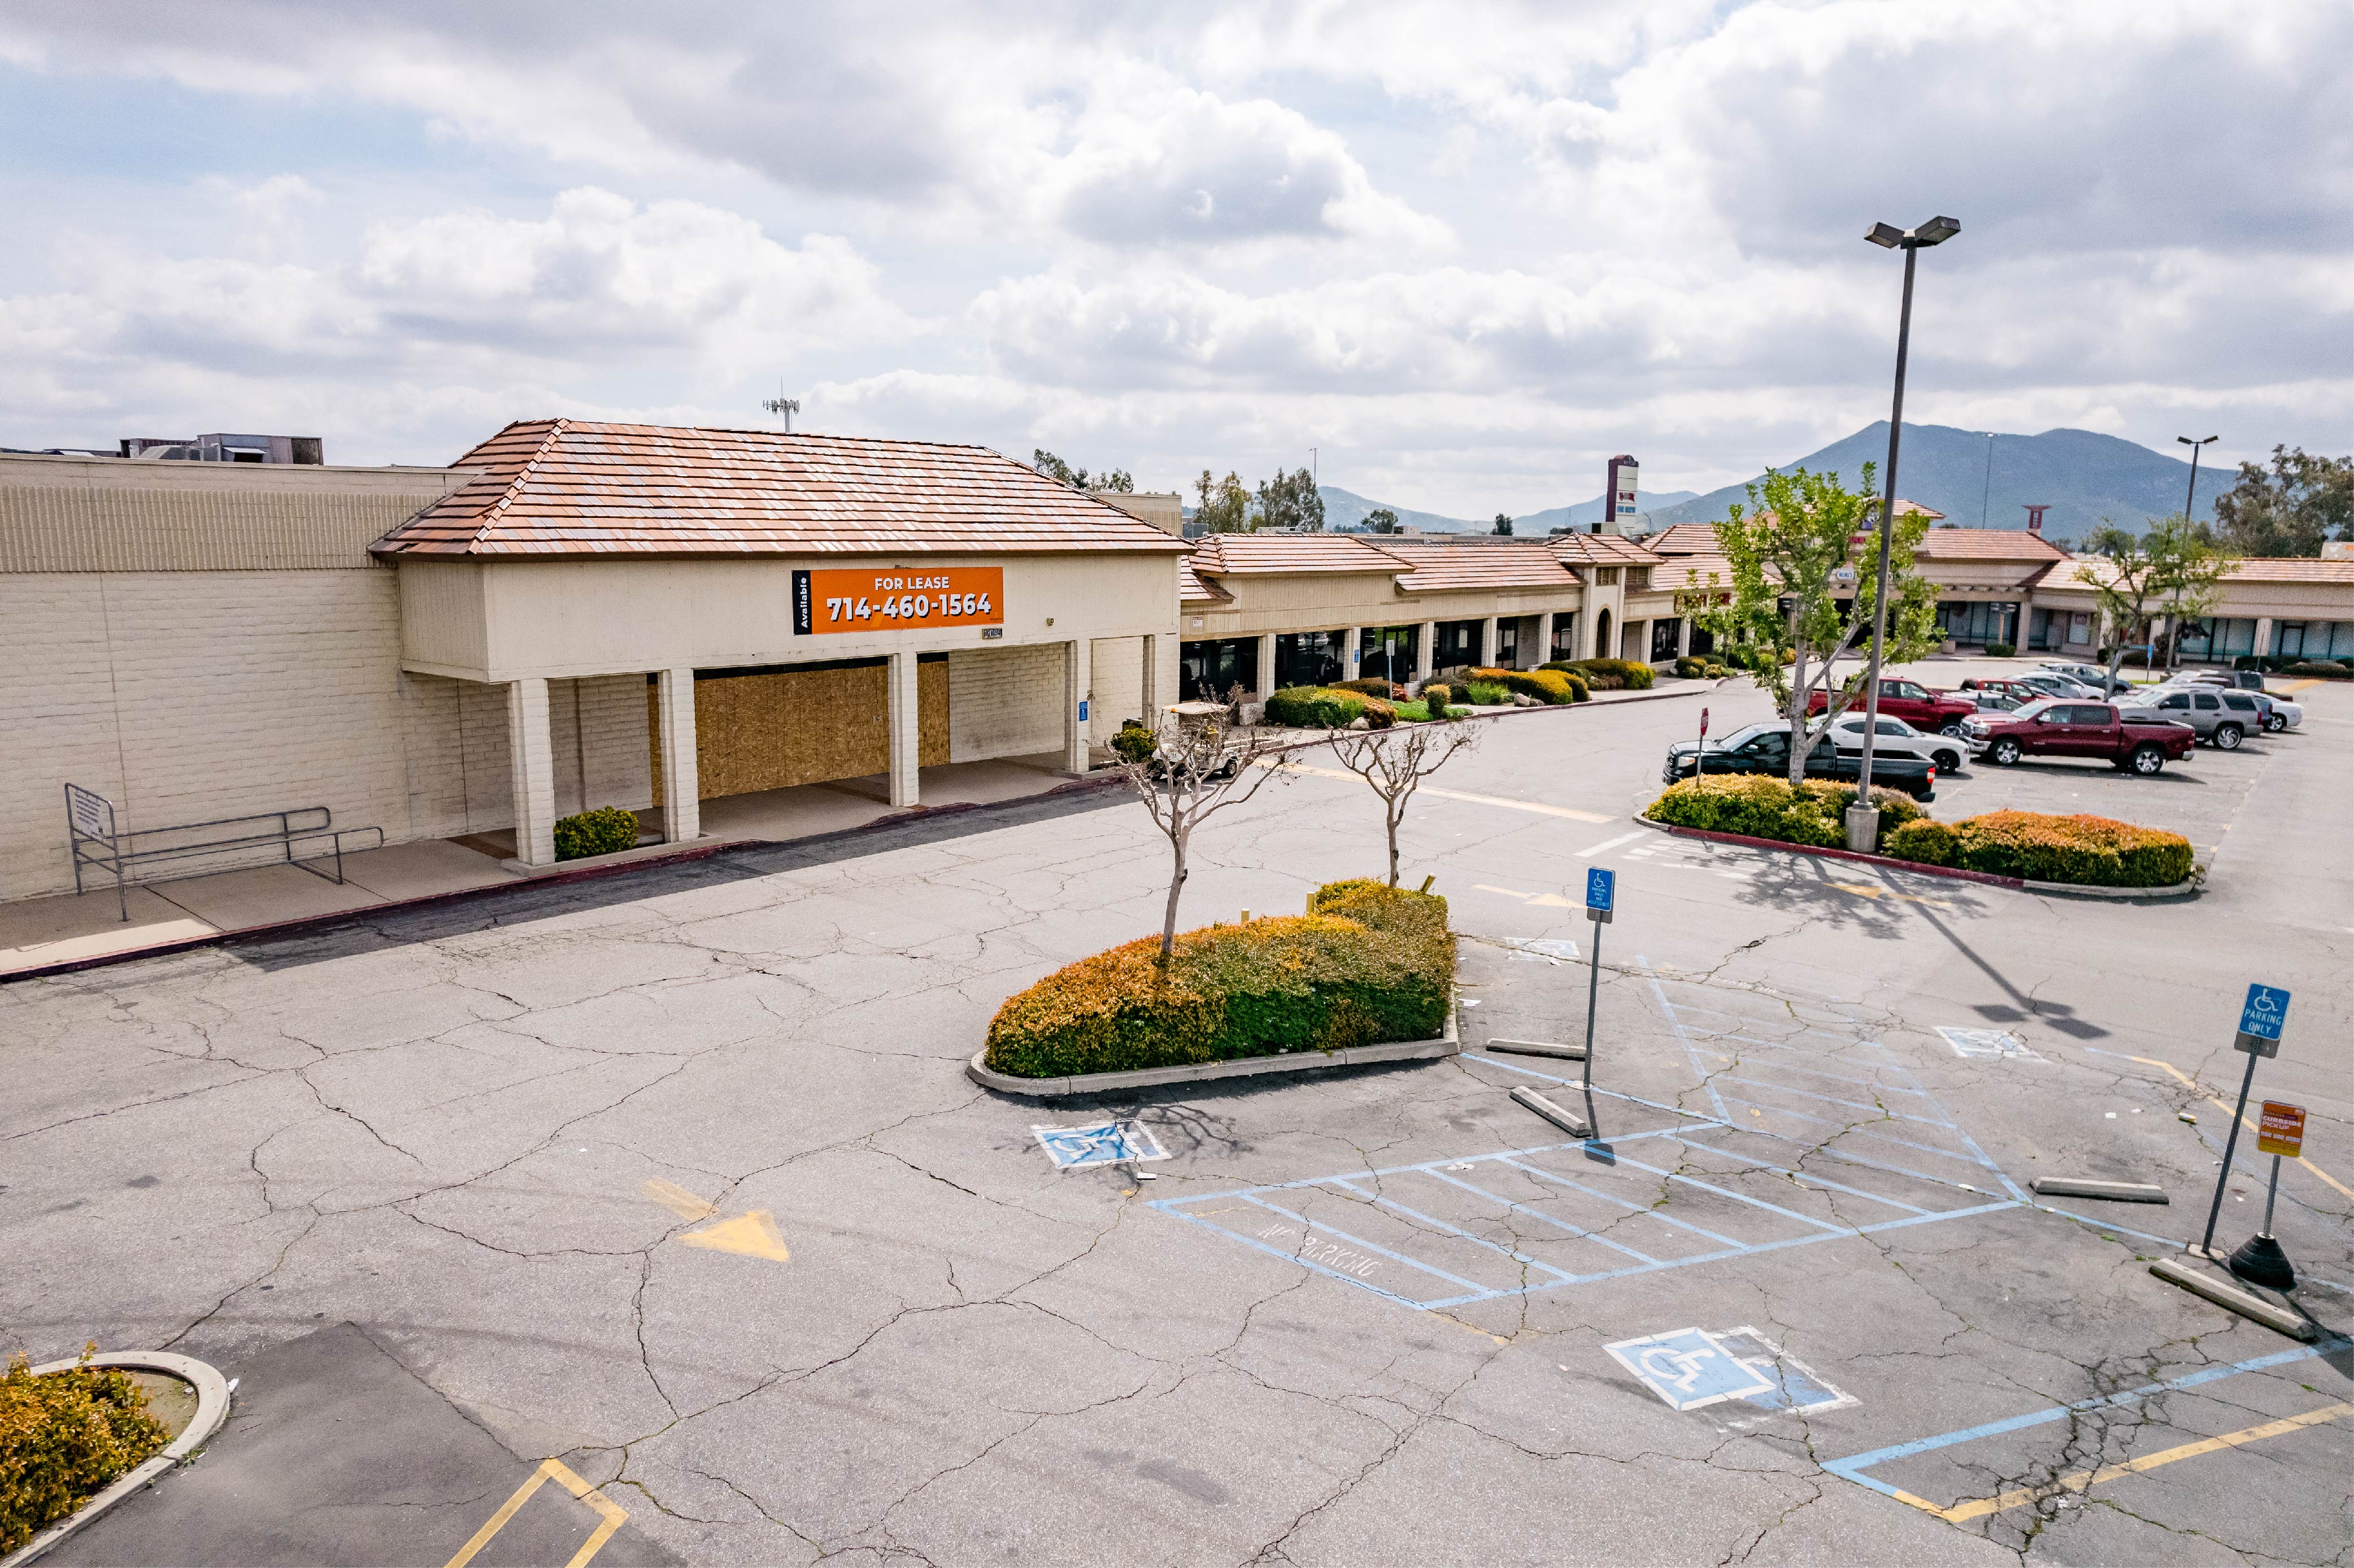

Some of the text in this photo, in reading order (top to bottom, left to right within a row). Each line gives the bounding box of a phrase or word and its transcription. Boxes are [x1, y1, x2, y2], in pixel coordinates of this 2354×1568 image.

[874, 576, 950, 591] FOR LEASE
[826, 593, 991, 621] 714-460-1564
[2244, 1008, 2282, 1026] PARKING
[2248, 1021, 2272, 1034] ONLY
[2262, 1115, 2302, 1128] CURBSIDE
[2262, 1121, 2290, 1130] PICKUP
[1300, 1236, 1382, 1277] PARKING
